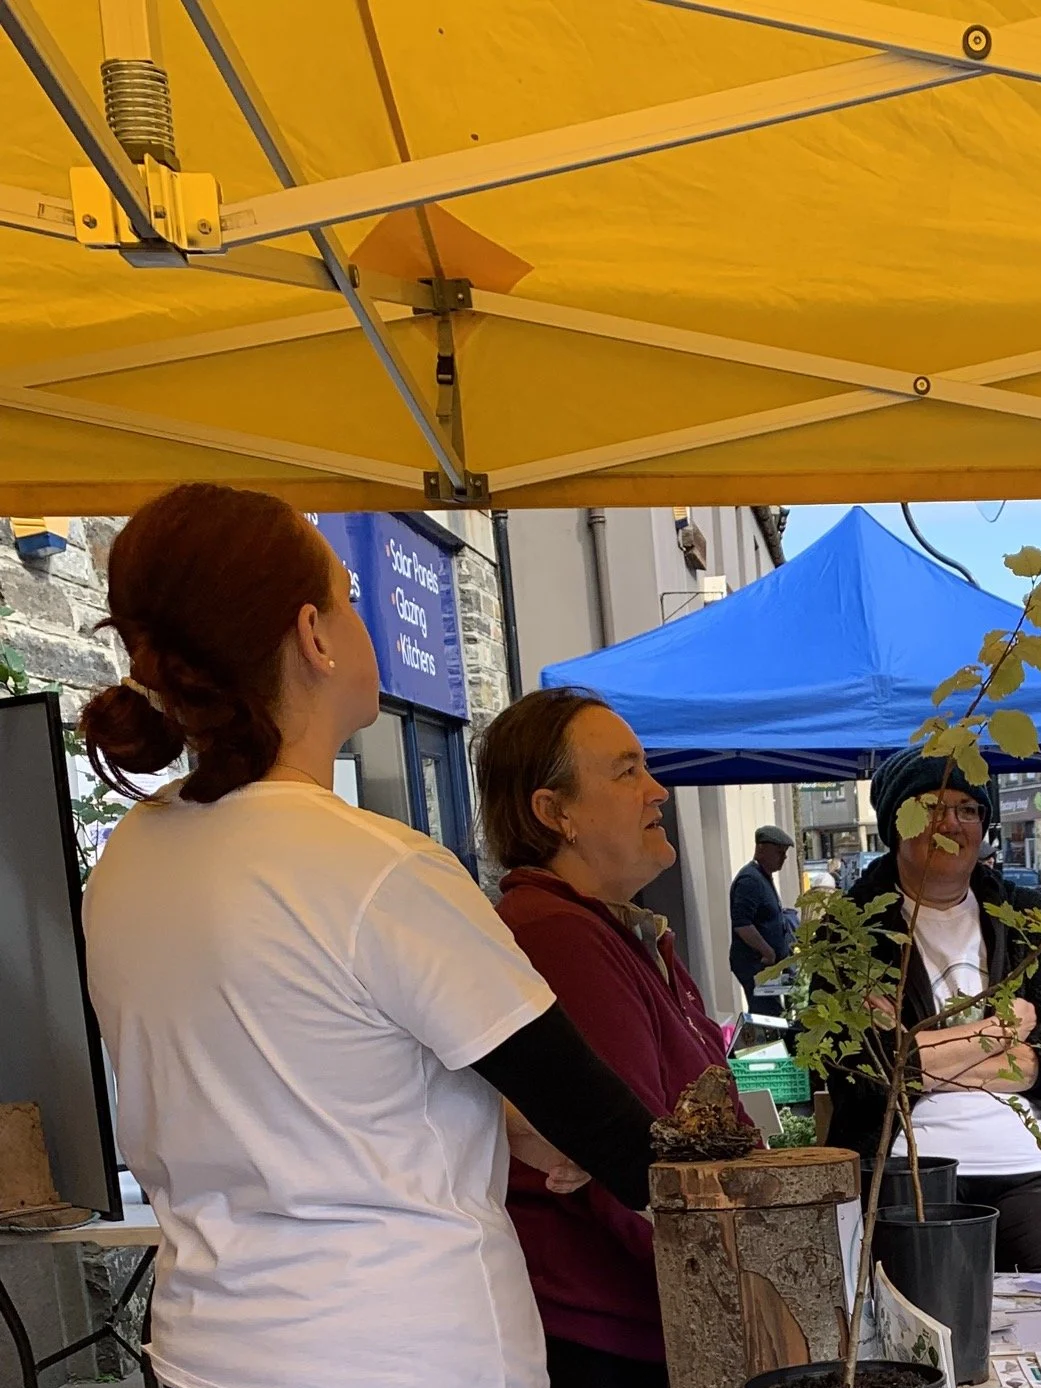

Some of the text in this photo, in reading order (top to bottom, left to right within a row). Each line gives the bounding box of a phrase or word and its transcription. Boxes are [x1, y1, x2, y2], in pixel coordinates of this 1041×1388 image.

[389, 538, 439, 595] Solar Panels
[395, 586, 428, 639] Glazing
[400, 632, 436, 677] Kitchens
